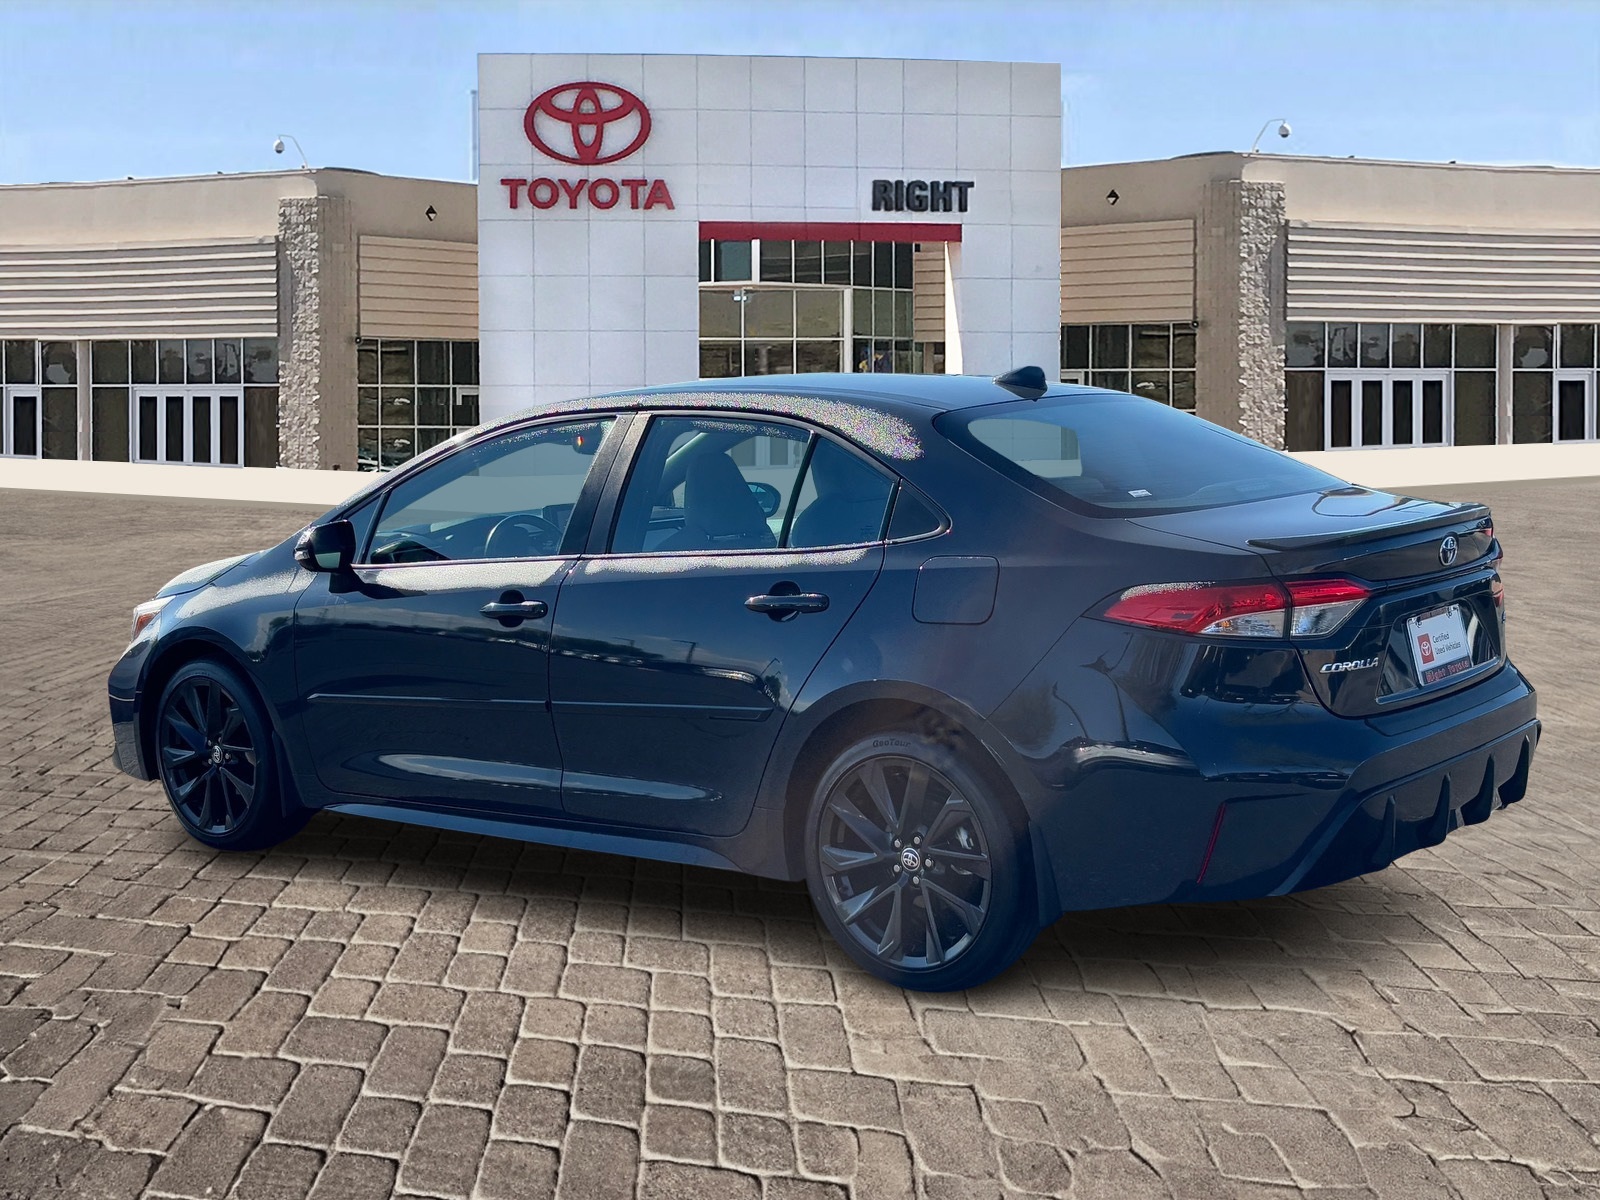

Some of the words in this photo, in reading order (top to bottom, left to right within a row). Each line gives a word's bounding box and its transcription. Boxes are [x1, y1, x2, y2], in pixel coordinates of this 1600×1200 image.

[501, 177, 675, 210] TOYOTA
[872, 180, 975, 212] RIGHT
[1432, 631, 1450, 644] Certified
[1319, 657, 1379, 673] COROLLA
